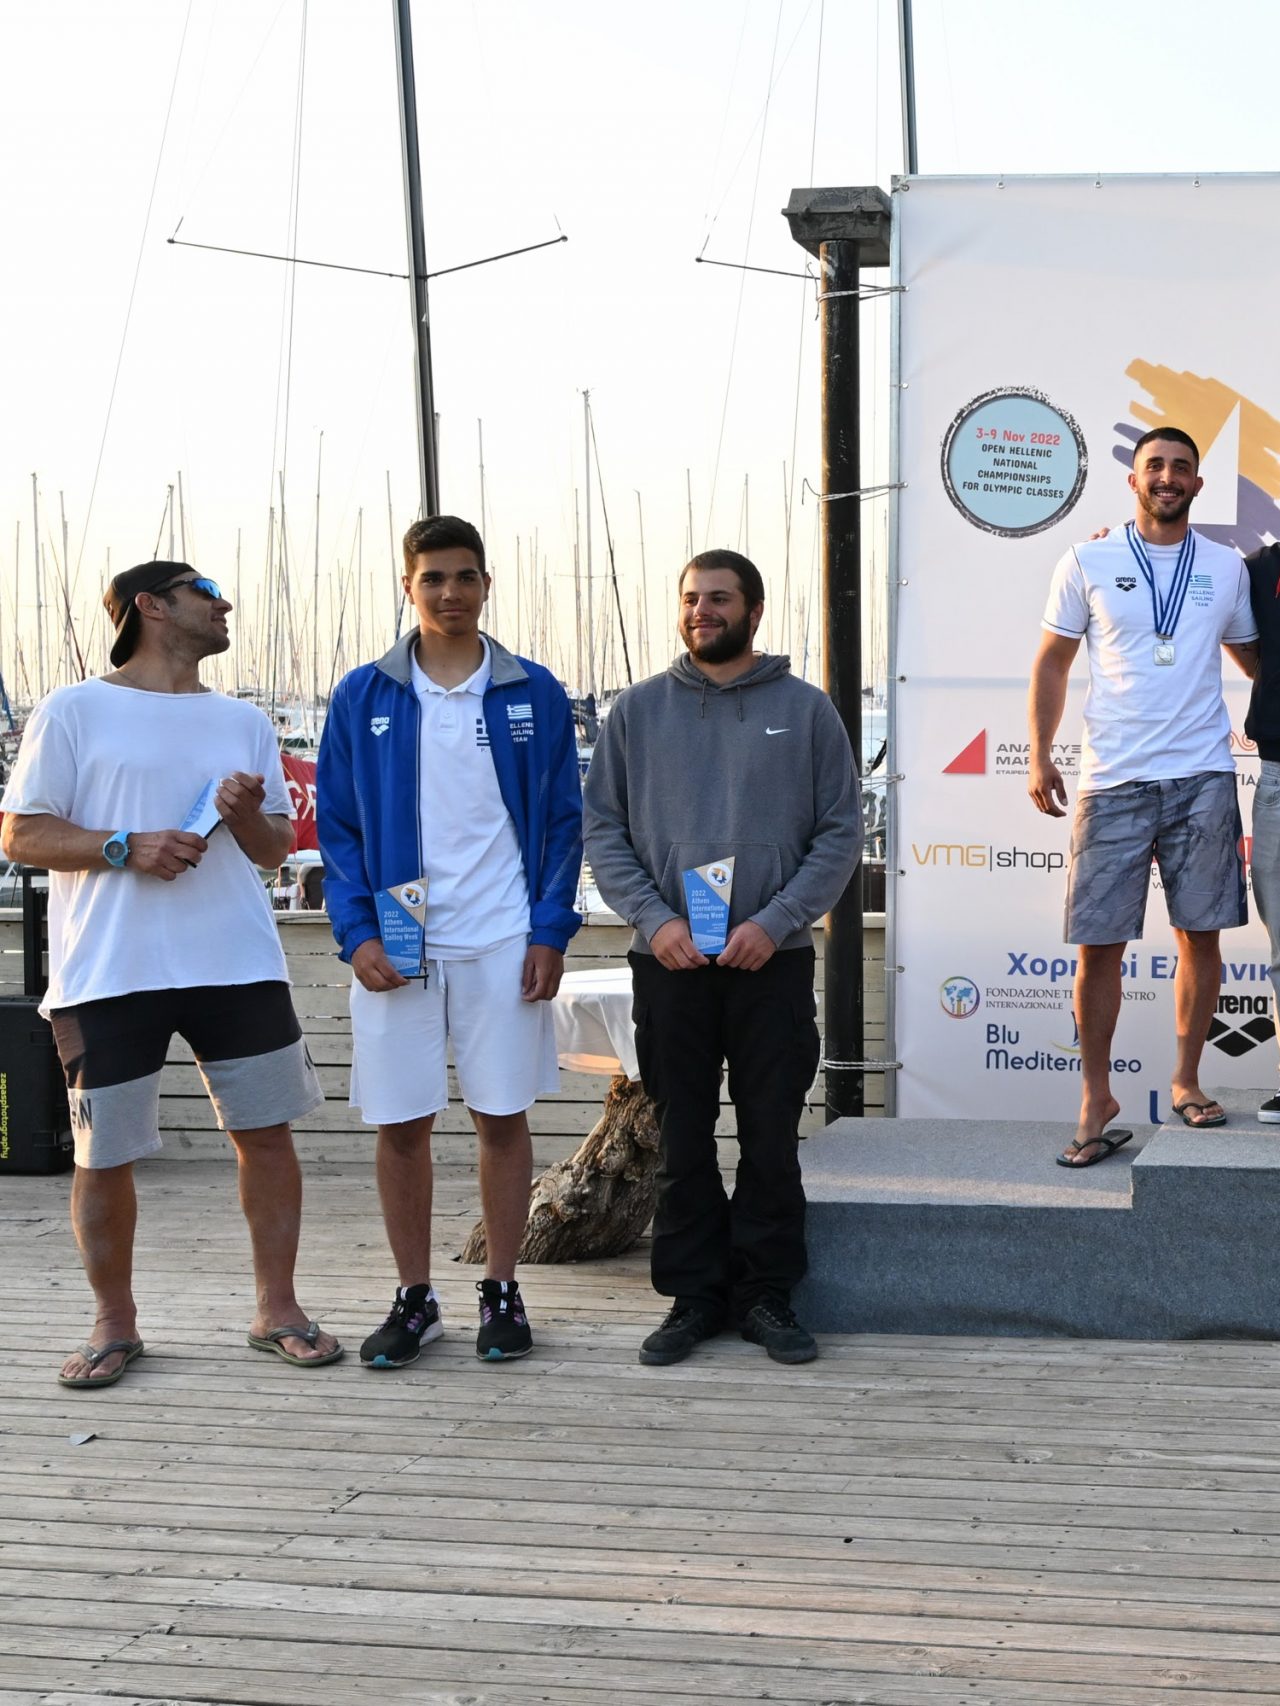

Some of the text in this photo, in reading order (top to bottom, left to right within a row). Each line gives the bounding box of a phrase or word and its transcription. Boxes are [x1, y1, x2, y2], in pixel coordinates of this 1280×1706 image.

[976, 427, 1061, 446] 3-9 Nov 2022
[981, 443, 1052, 458] OPEN HELLENIC
[993, 457, 1038, 470] NATIONAL
[977, 469, 1052, 485] CHAMPIONSHIPS
[962, 481, 1064, 499] FOR OLYMPIC CLASSES
[986, 987, 1061, 999] FONDAZIONE
[985, 1000, 1064, 1010] INTERNAZIONALE
[1213, 994, 1268, 1015] rena
[986, 1024, 1020, 1044] Blu
[0, 1072, 10, 1159] zagasphotography
